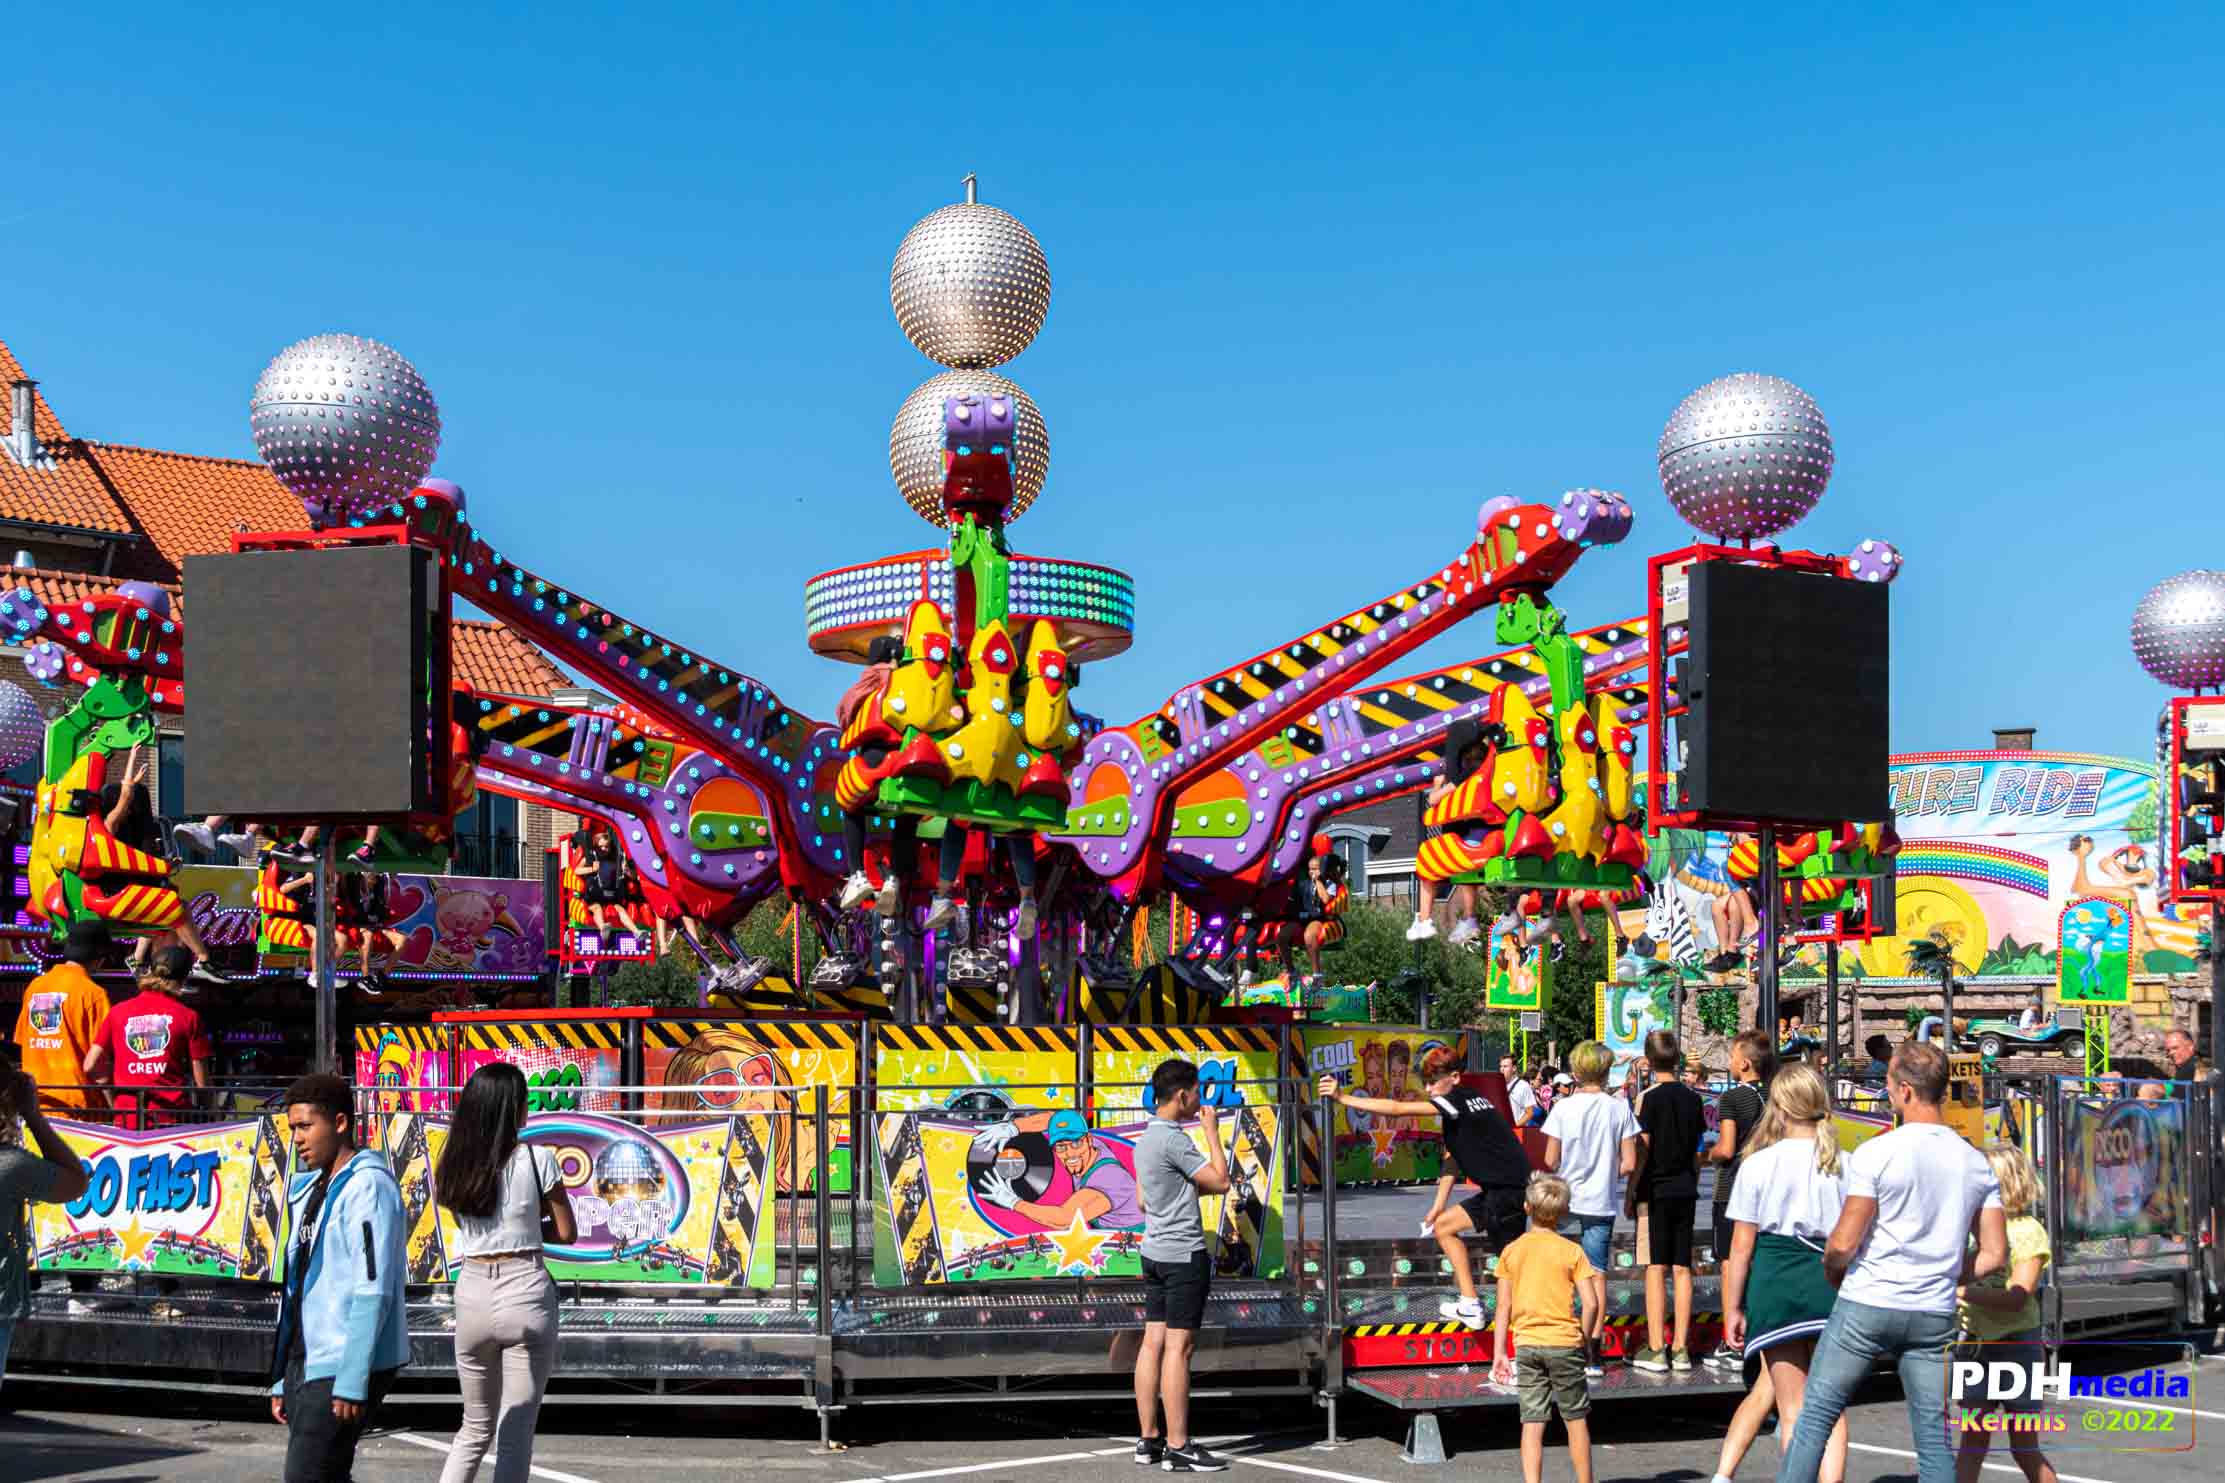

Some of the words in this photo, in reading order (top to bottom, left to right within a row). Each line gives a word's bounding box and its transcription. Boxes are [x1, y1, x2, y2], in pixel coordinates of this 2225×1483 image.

[1989, 767, 2106, 818] RIDE
[29, 1038, 64, 1049] CREW
[128, 1062, 168, 1074] CREW
[125, 1150, 221, 1214] FAST
[1404, 1337, 1478, 1360] STOP
